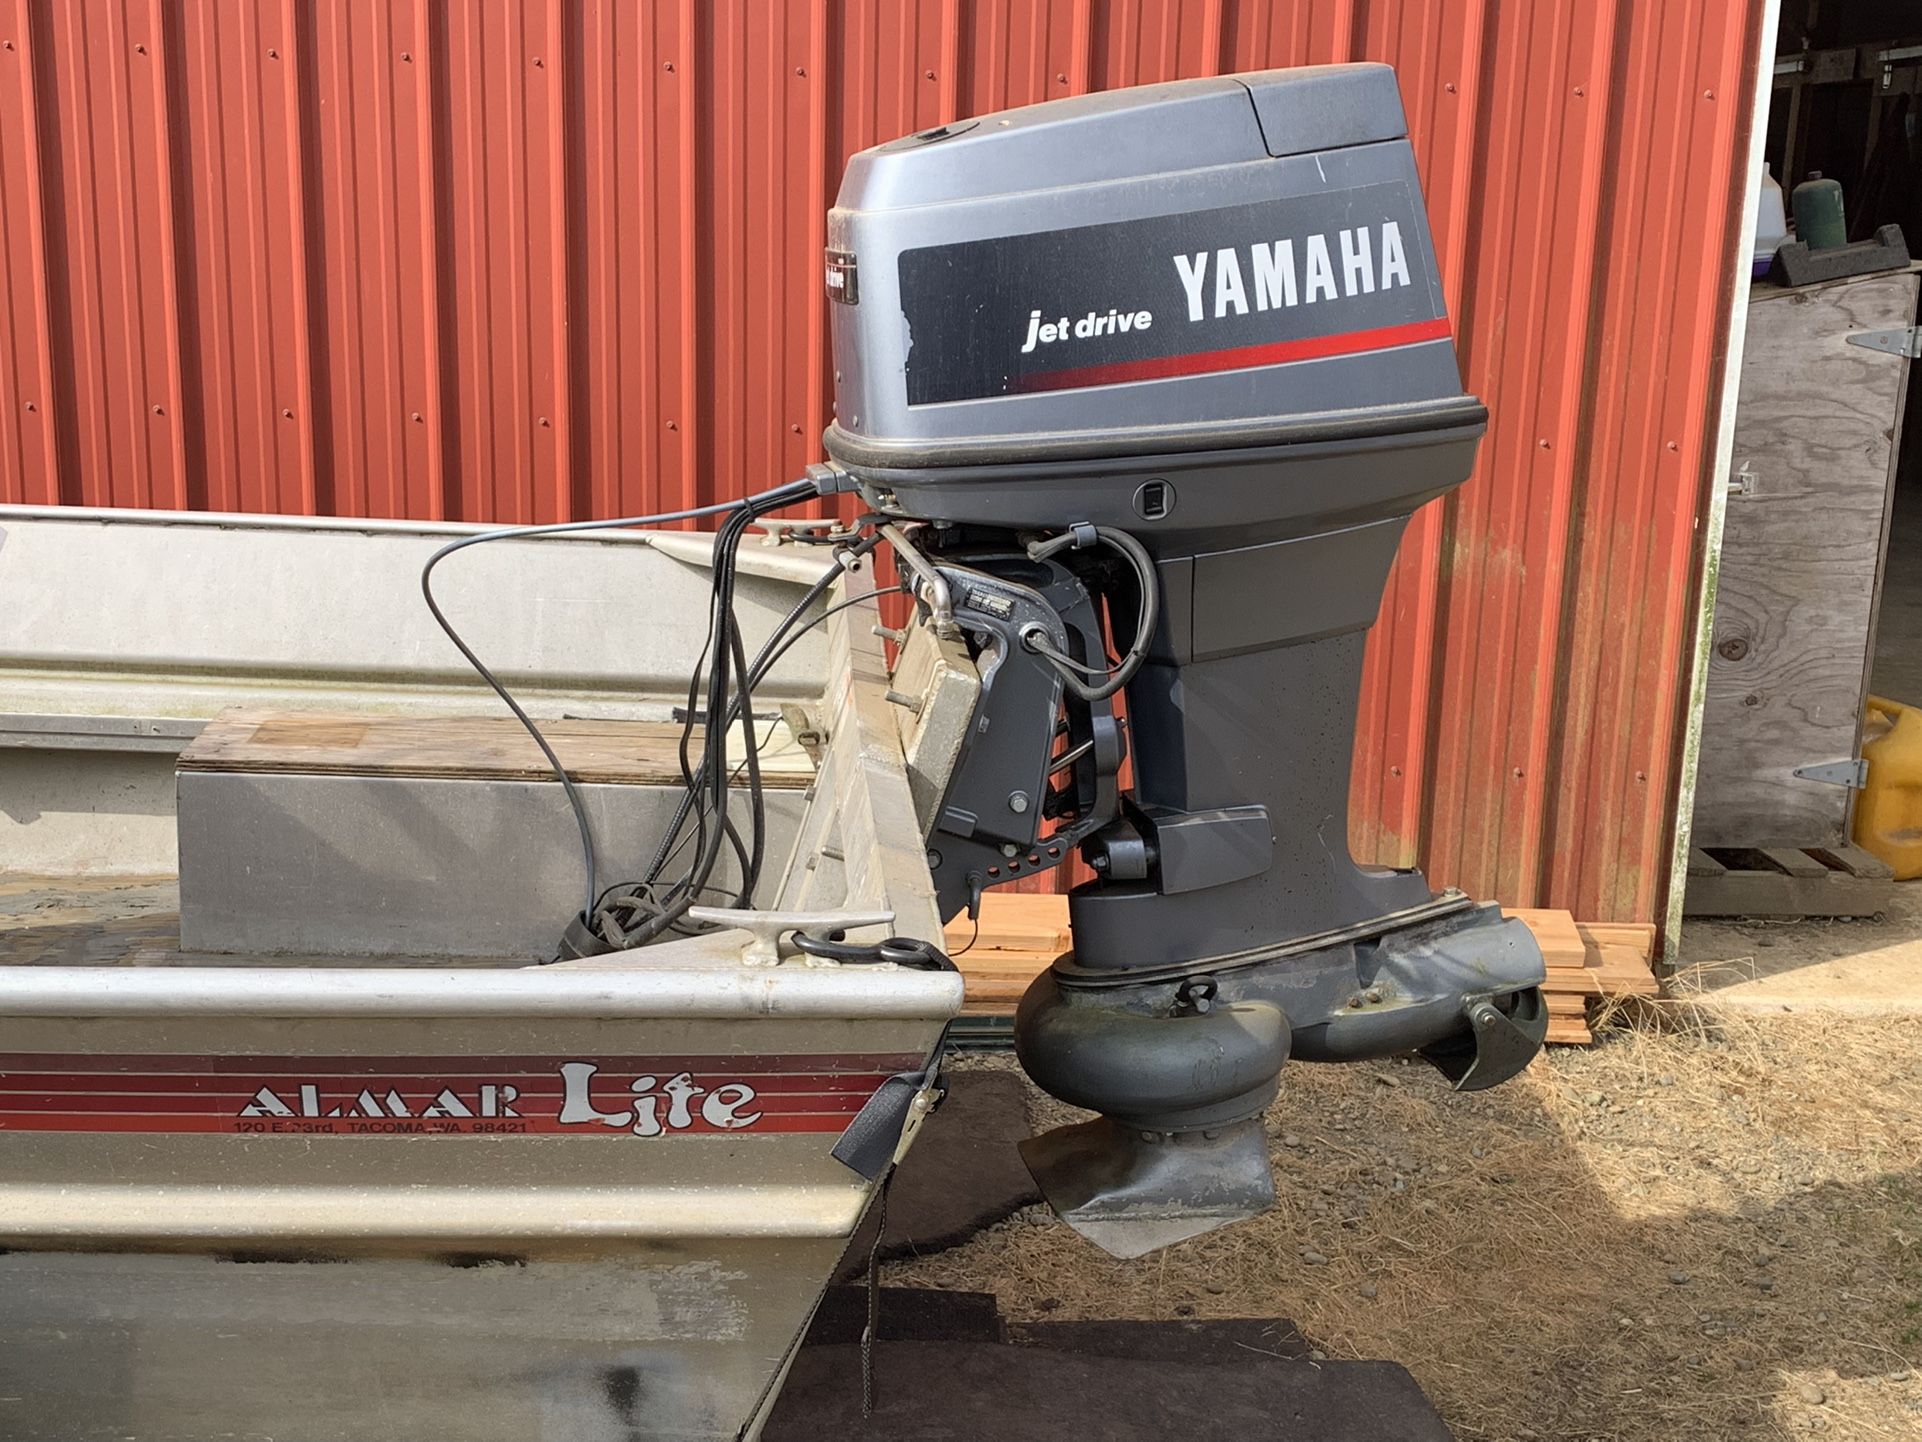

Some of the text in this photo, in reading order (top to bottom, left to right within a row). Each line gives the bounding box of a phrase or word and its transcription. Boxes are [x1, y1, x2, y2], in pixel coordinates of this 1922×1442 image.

[1173, 221, 1411, 322] YAMAHA
[1021, 309, 1153, 353] jet drive
[233, 1122, 265, 1133] 120
[472, 1122, 526, 1133] 98421
[237, 1061, 763, 1137] ALMAR Lite
